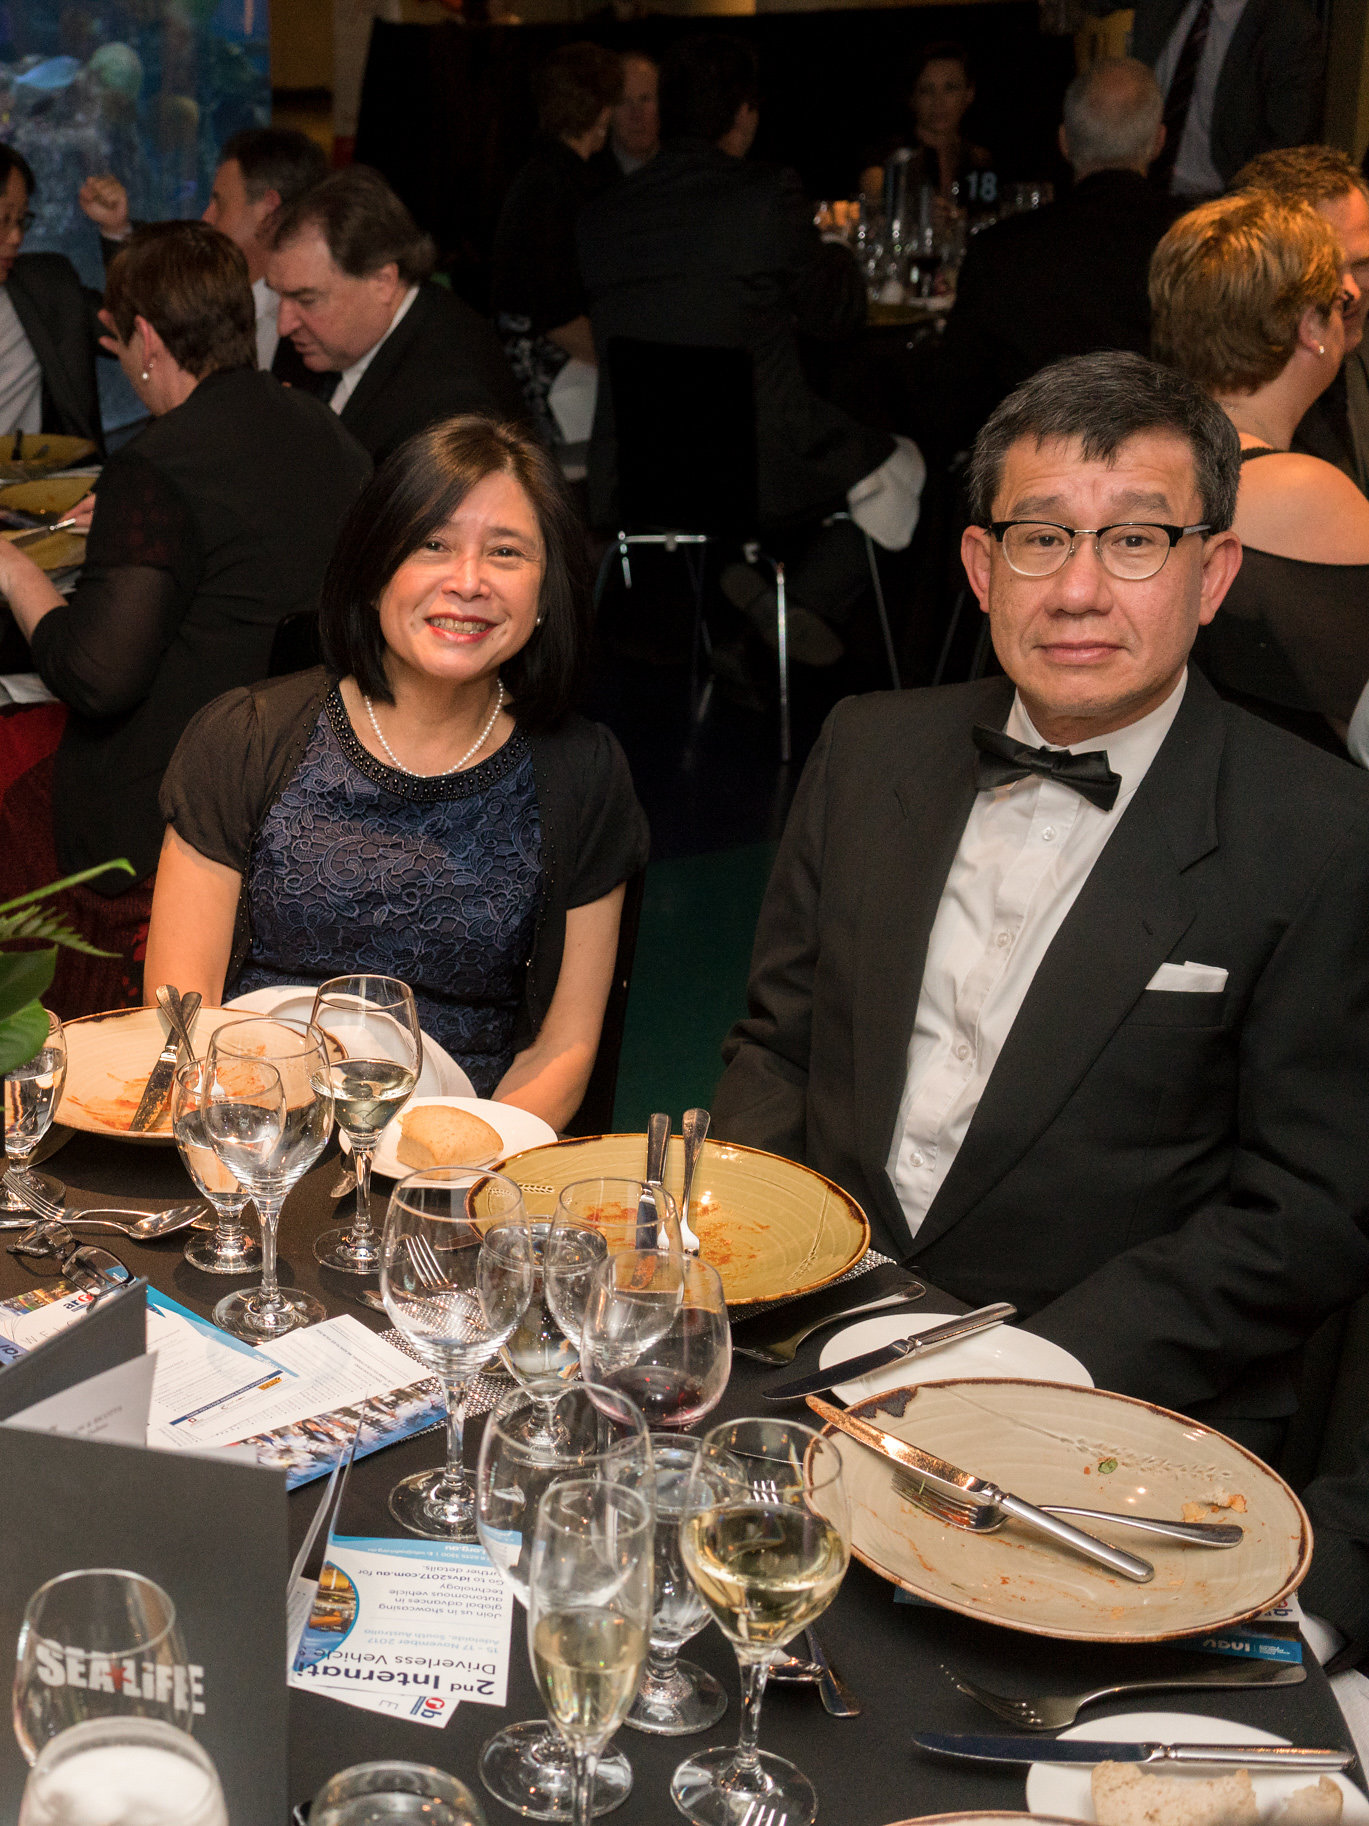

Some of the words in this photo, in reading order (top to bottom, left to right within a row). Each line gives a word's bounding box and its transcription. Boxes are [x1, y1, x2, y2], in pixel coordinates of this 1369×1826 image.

[966, 170, 998, 203] 18
[63, 1289, 93, 1312] arr
[357, 1568, 372, 1576] for
[422, 1564, 463, 1574] details.
[466, 1568, 499, 1577] urther
[375, 1568, 470, 1584] idvs2017.com.au
[472, 1576, 485, 1584] to
[388, 1588, 428, 1598] vehicle
[439, 1582, 503, 1595] technology
[407, 1597, 462, 1608] advances
[431, 1591, 502, 1603] autonomous
[378, 1602, 443, 1615] showcasing
[465, 1601, 502, 1611] global
[475, 1611, 501, 1619] Join
[367, 1636, 394, 1645] 2017
[398, 1638, 458, 1650] November
[313, 1647, 387, 1664] Vehicle
[35, 1638, 116, 1694] SEA
[394, 1654, 495, 1674] Driverless
[450, 1678, 494, 1695] 2nd
